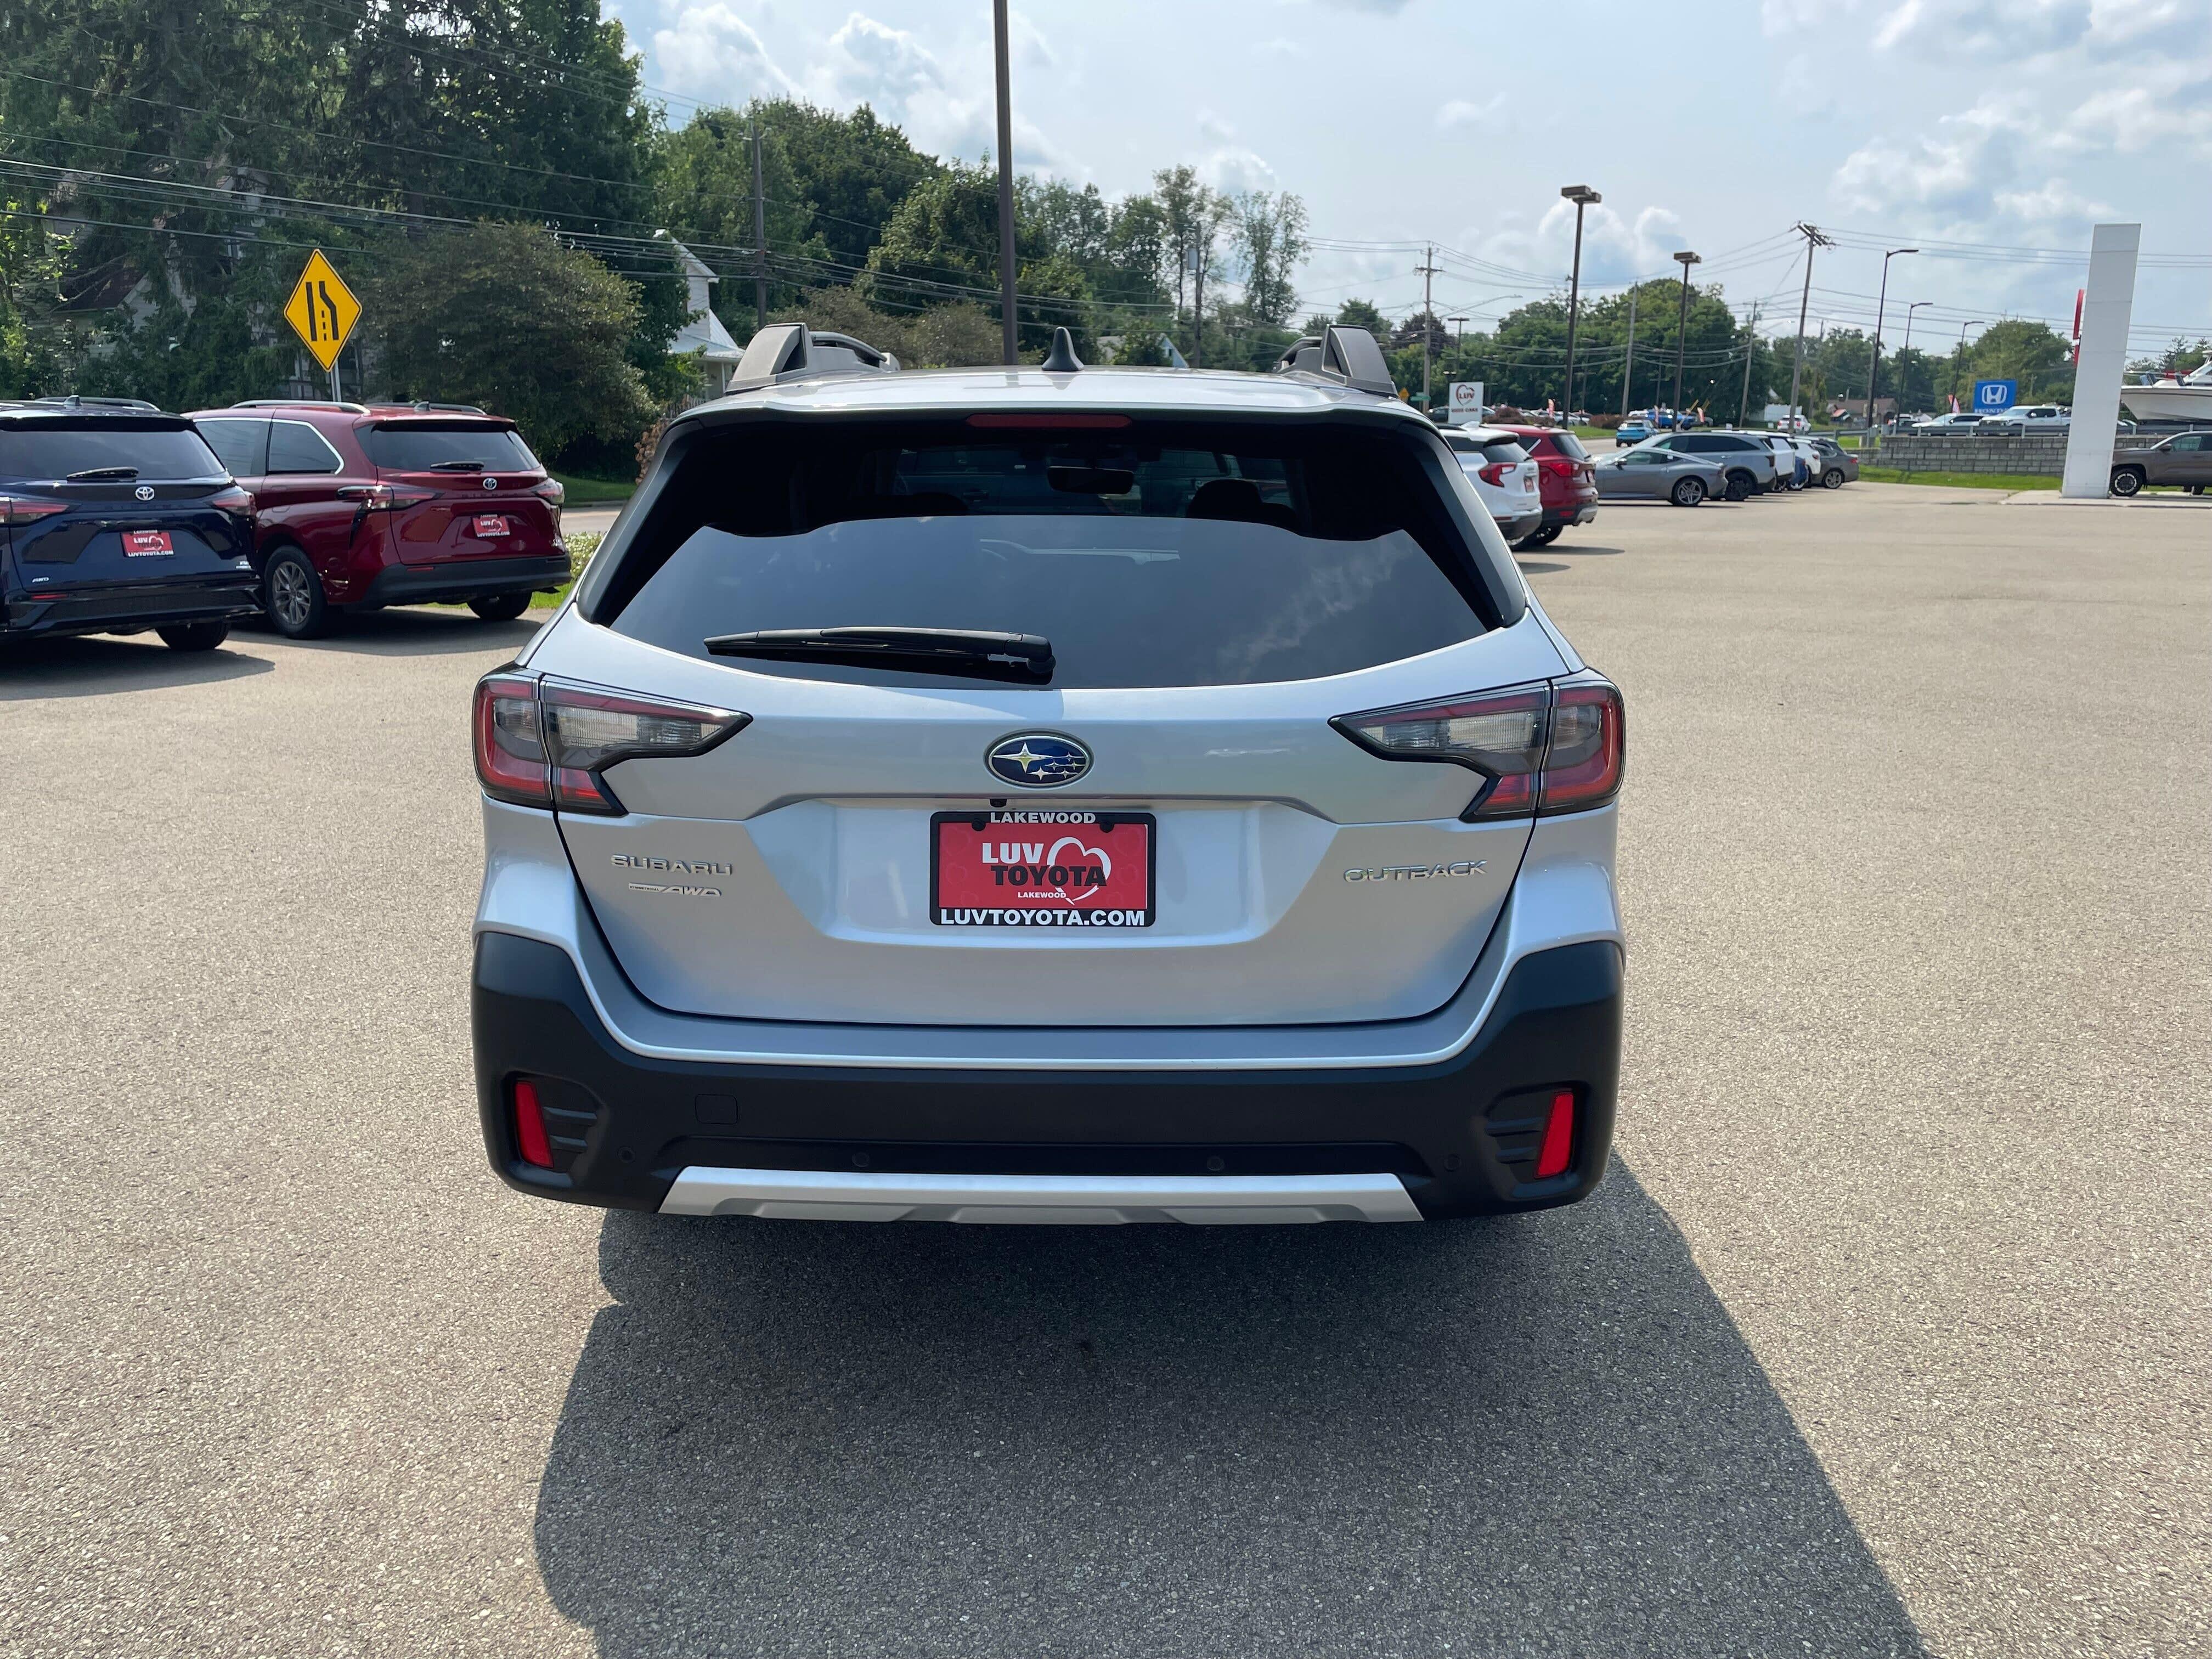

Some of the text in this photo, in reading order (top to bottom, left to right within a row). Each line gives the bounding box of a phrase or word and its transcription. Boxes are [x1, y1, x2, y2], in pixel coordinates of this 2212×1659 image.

[990, 812, 1096, 824] LAKEWOOD
[981, 843, 1045, 864] LUV
[611, 854, 732, 877] SUBARU
[990, 865, 1107, 887] TOYOTA
[1344, 859, 1488, 883] OUTBACK
[662, 884, 722, 897] AWD
[941, 909, 1145, 927] LUVTOYOTA.COM
